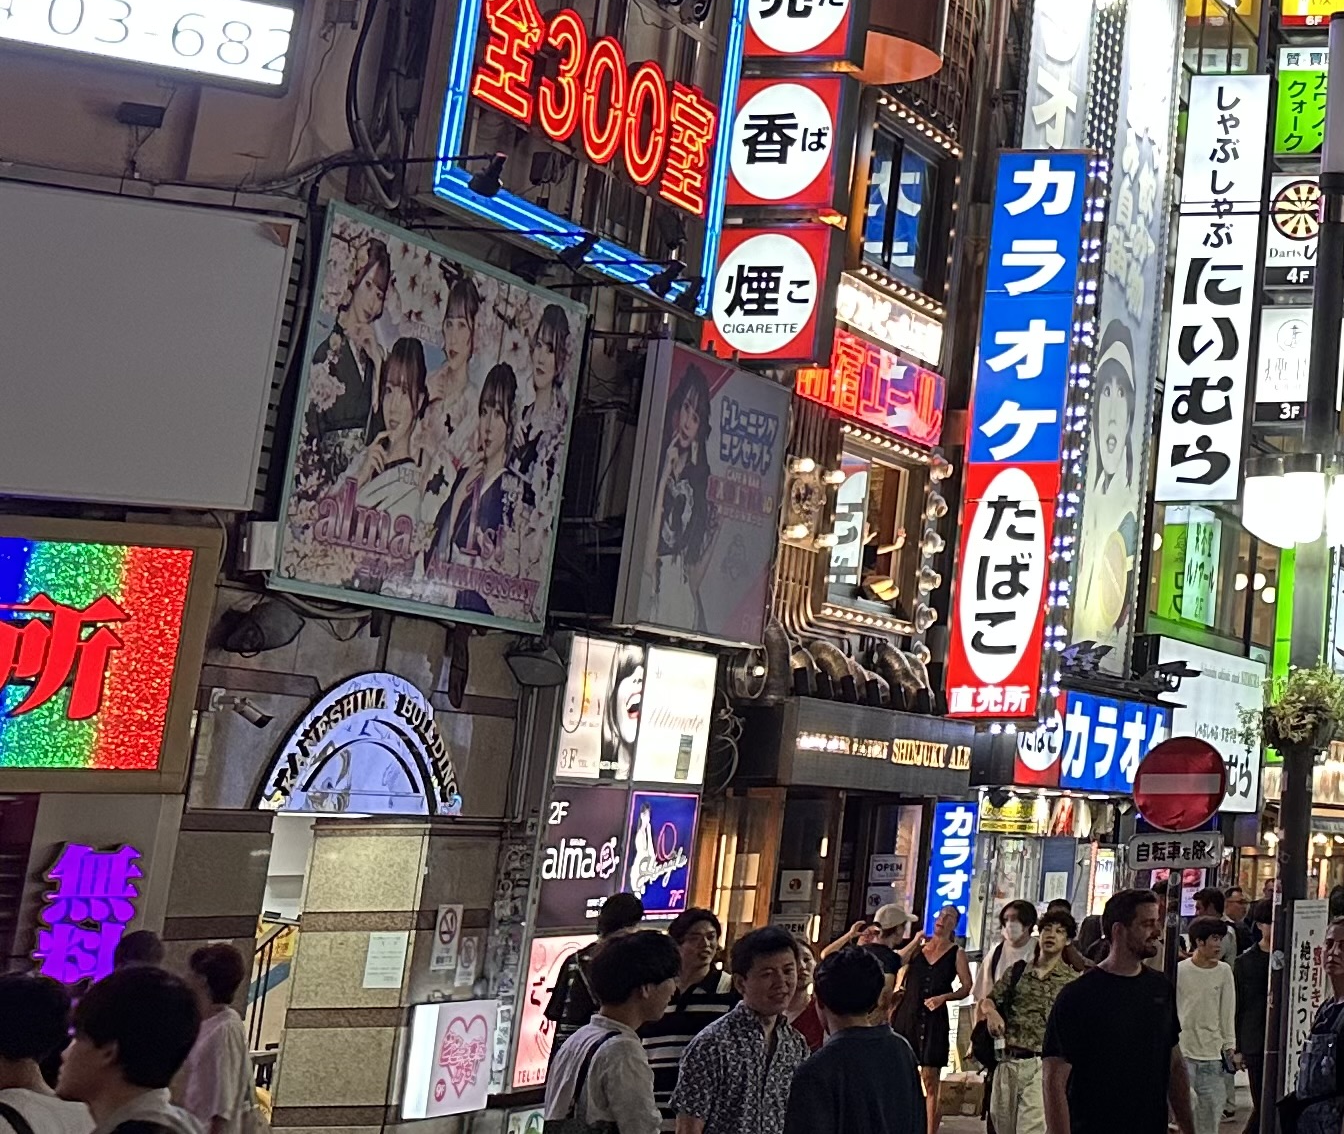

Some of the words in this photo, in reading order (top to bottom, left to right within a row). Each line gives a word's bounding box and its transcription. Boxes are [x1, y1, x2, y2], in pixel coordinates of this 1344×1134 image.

[1286, 270, 1310, 283] 4F
[980, 159, 1077, 462] カラオケ
[722, 323, 799, 336] CIGARETTE
[1171, 257, 1244, 486] にいむら
[1280, 405, 1301, 419] 3F
[971, 494, 1038, 656] たばこ
[950, 684, 1030, 715] 直売所
[281, 687, 389, 798] KANESHIMA
[399, 697, 461, 804] BUILDING
[549, 801, 570, 824] 2F
[542, 838, 596, 880] alma
[1136, 839, 1215, 862] 自転車を除く
[876, 863, 903, 872] OPEN
